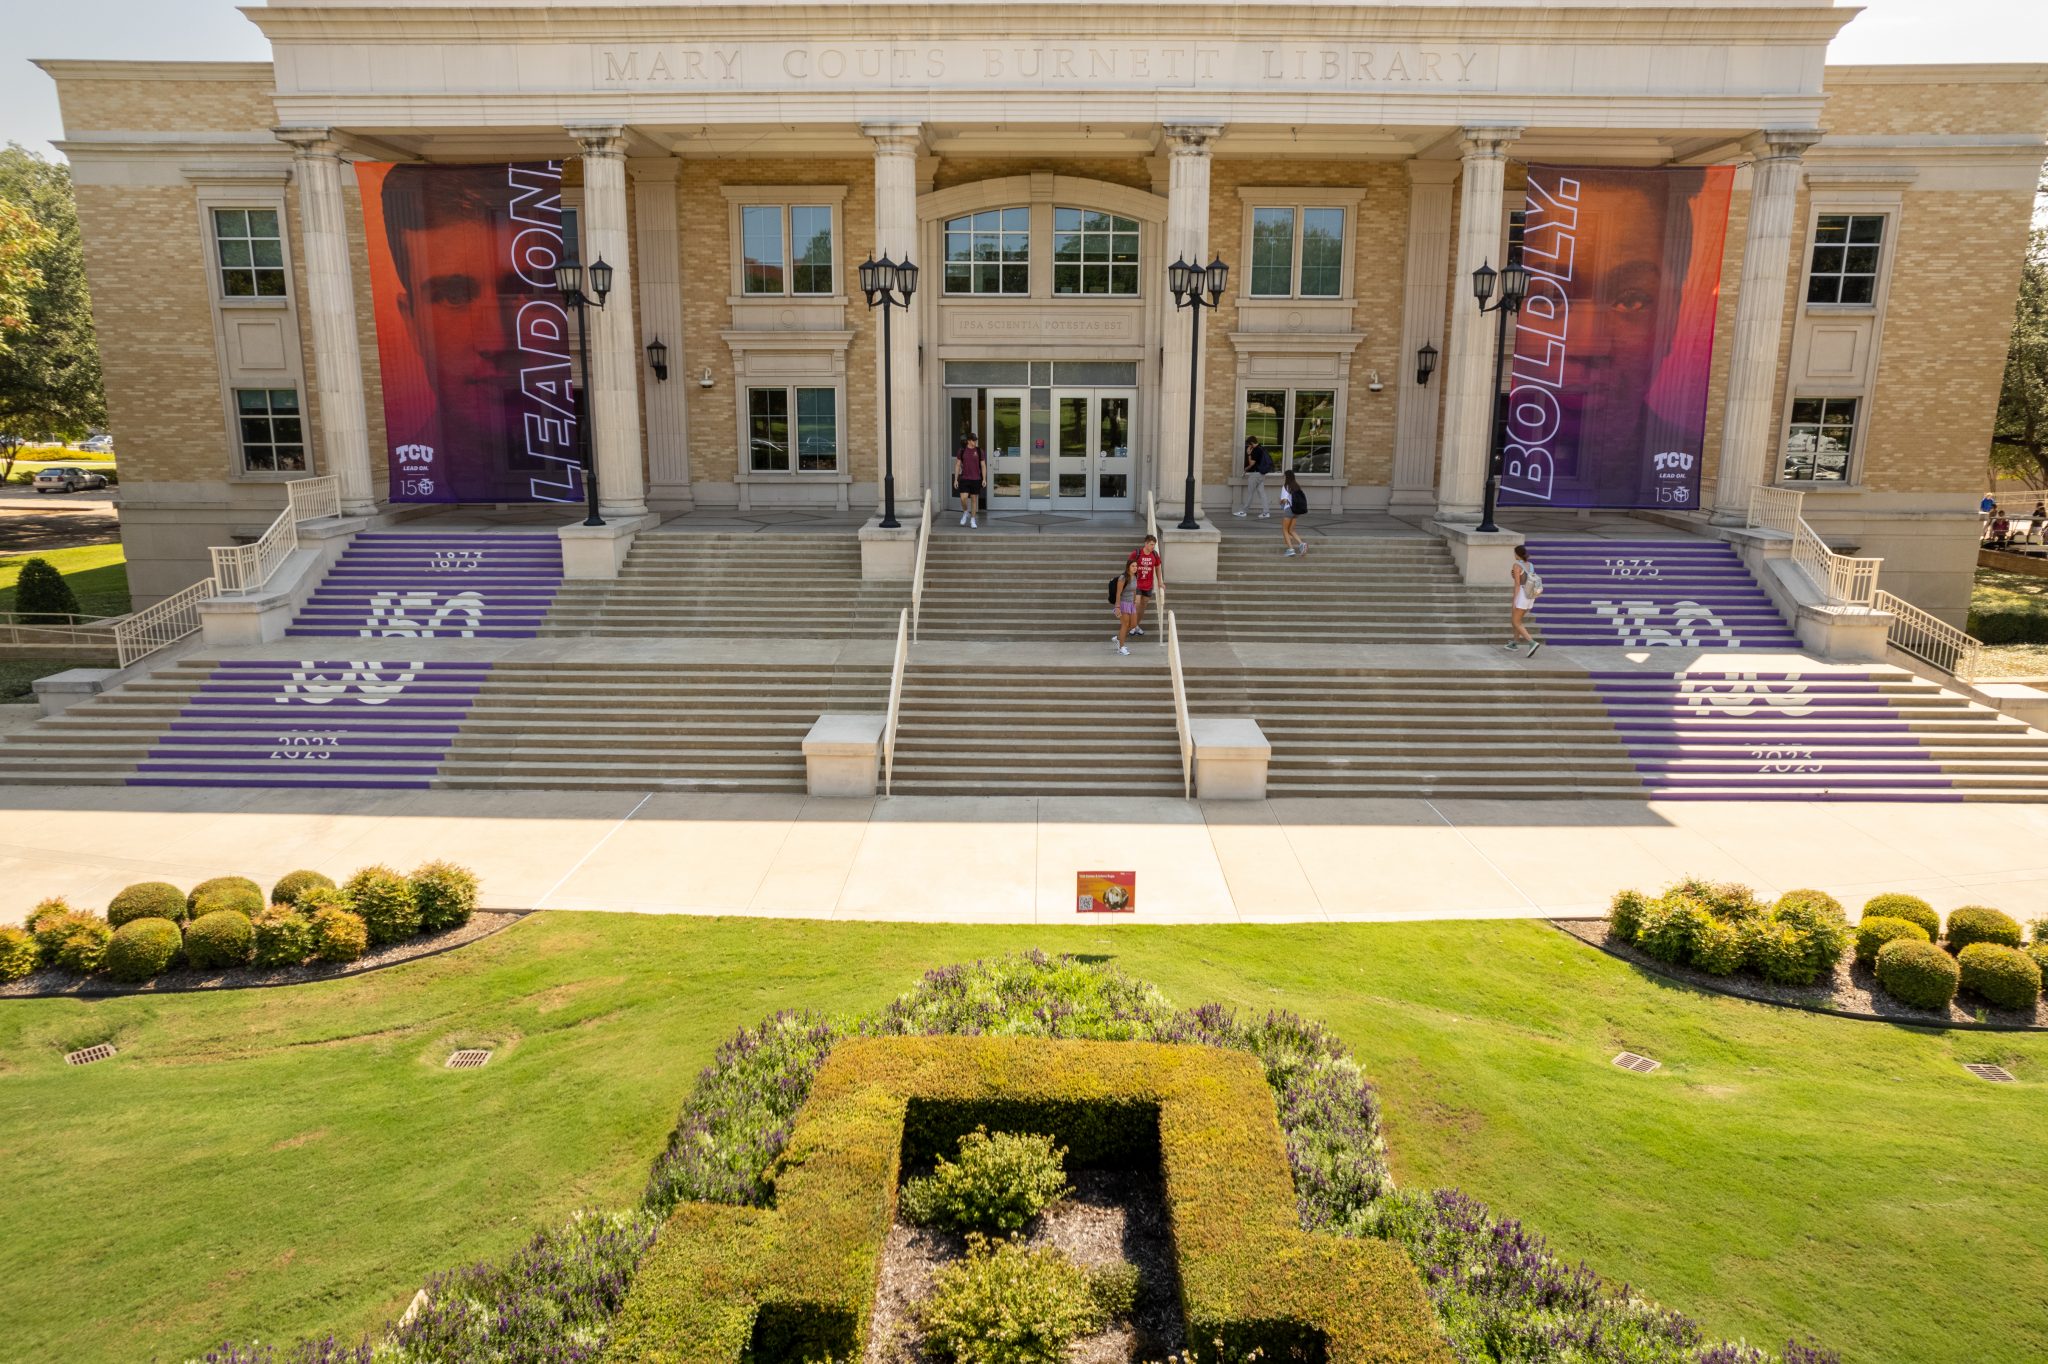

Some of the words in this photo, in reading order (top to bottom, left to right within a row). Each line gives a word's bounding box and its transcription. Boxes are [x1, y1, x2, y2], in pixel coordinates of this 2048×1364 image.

[605, 50, 739, 80] MARY
[782, 48, 946, 79] COUTS
[982, 48, 1219, 79] BURNETT
[1262, 50, 1477, 82] LIBRARY
[959, 320, 984, 330] IPSA
[987, 320, 1040, 330] SCIENTIA
[1045, 320, 1100, 330] POTESTAS
[1104, 321, 1123, 330] EST
[1500, 175, 1580, 500] BOLDLY.
[516, 300, 582, 502] LEAD
[395, 444, 434, 463] TCU
[1653, 452, 1694, 471] TCU
[424, 552, 483, 572] 1873
[1604, 560, 1664, 580] 1873
[270, 730, 347, 759] 2023
[1744, 743, 1823, 773] 2023
